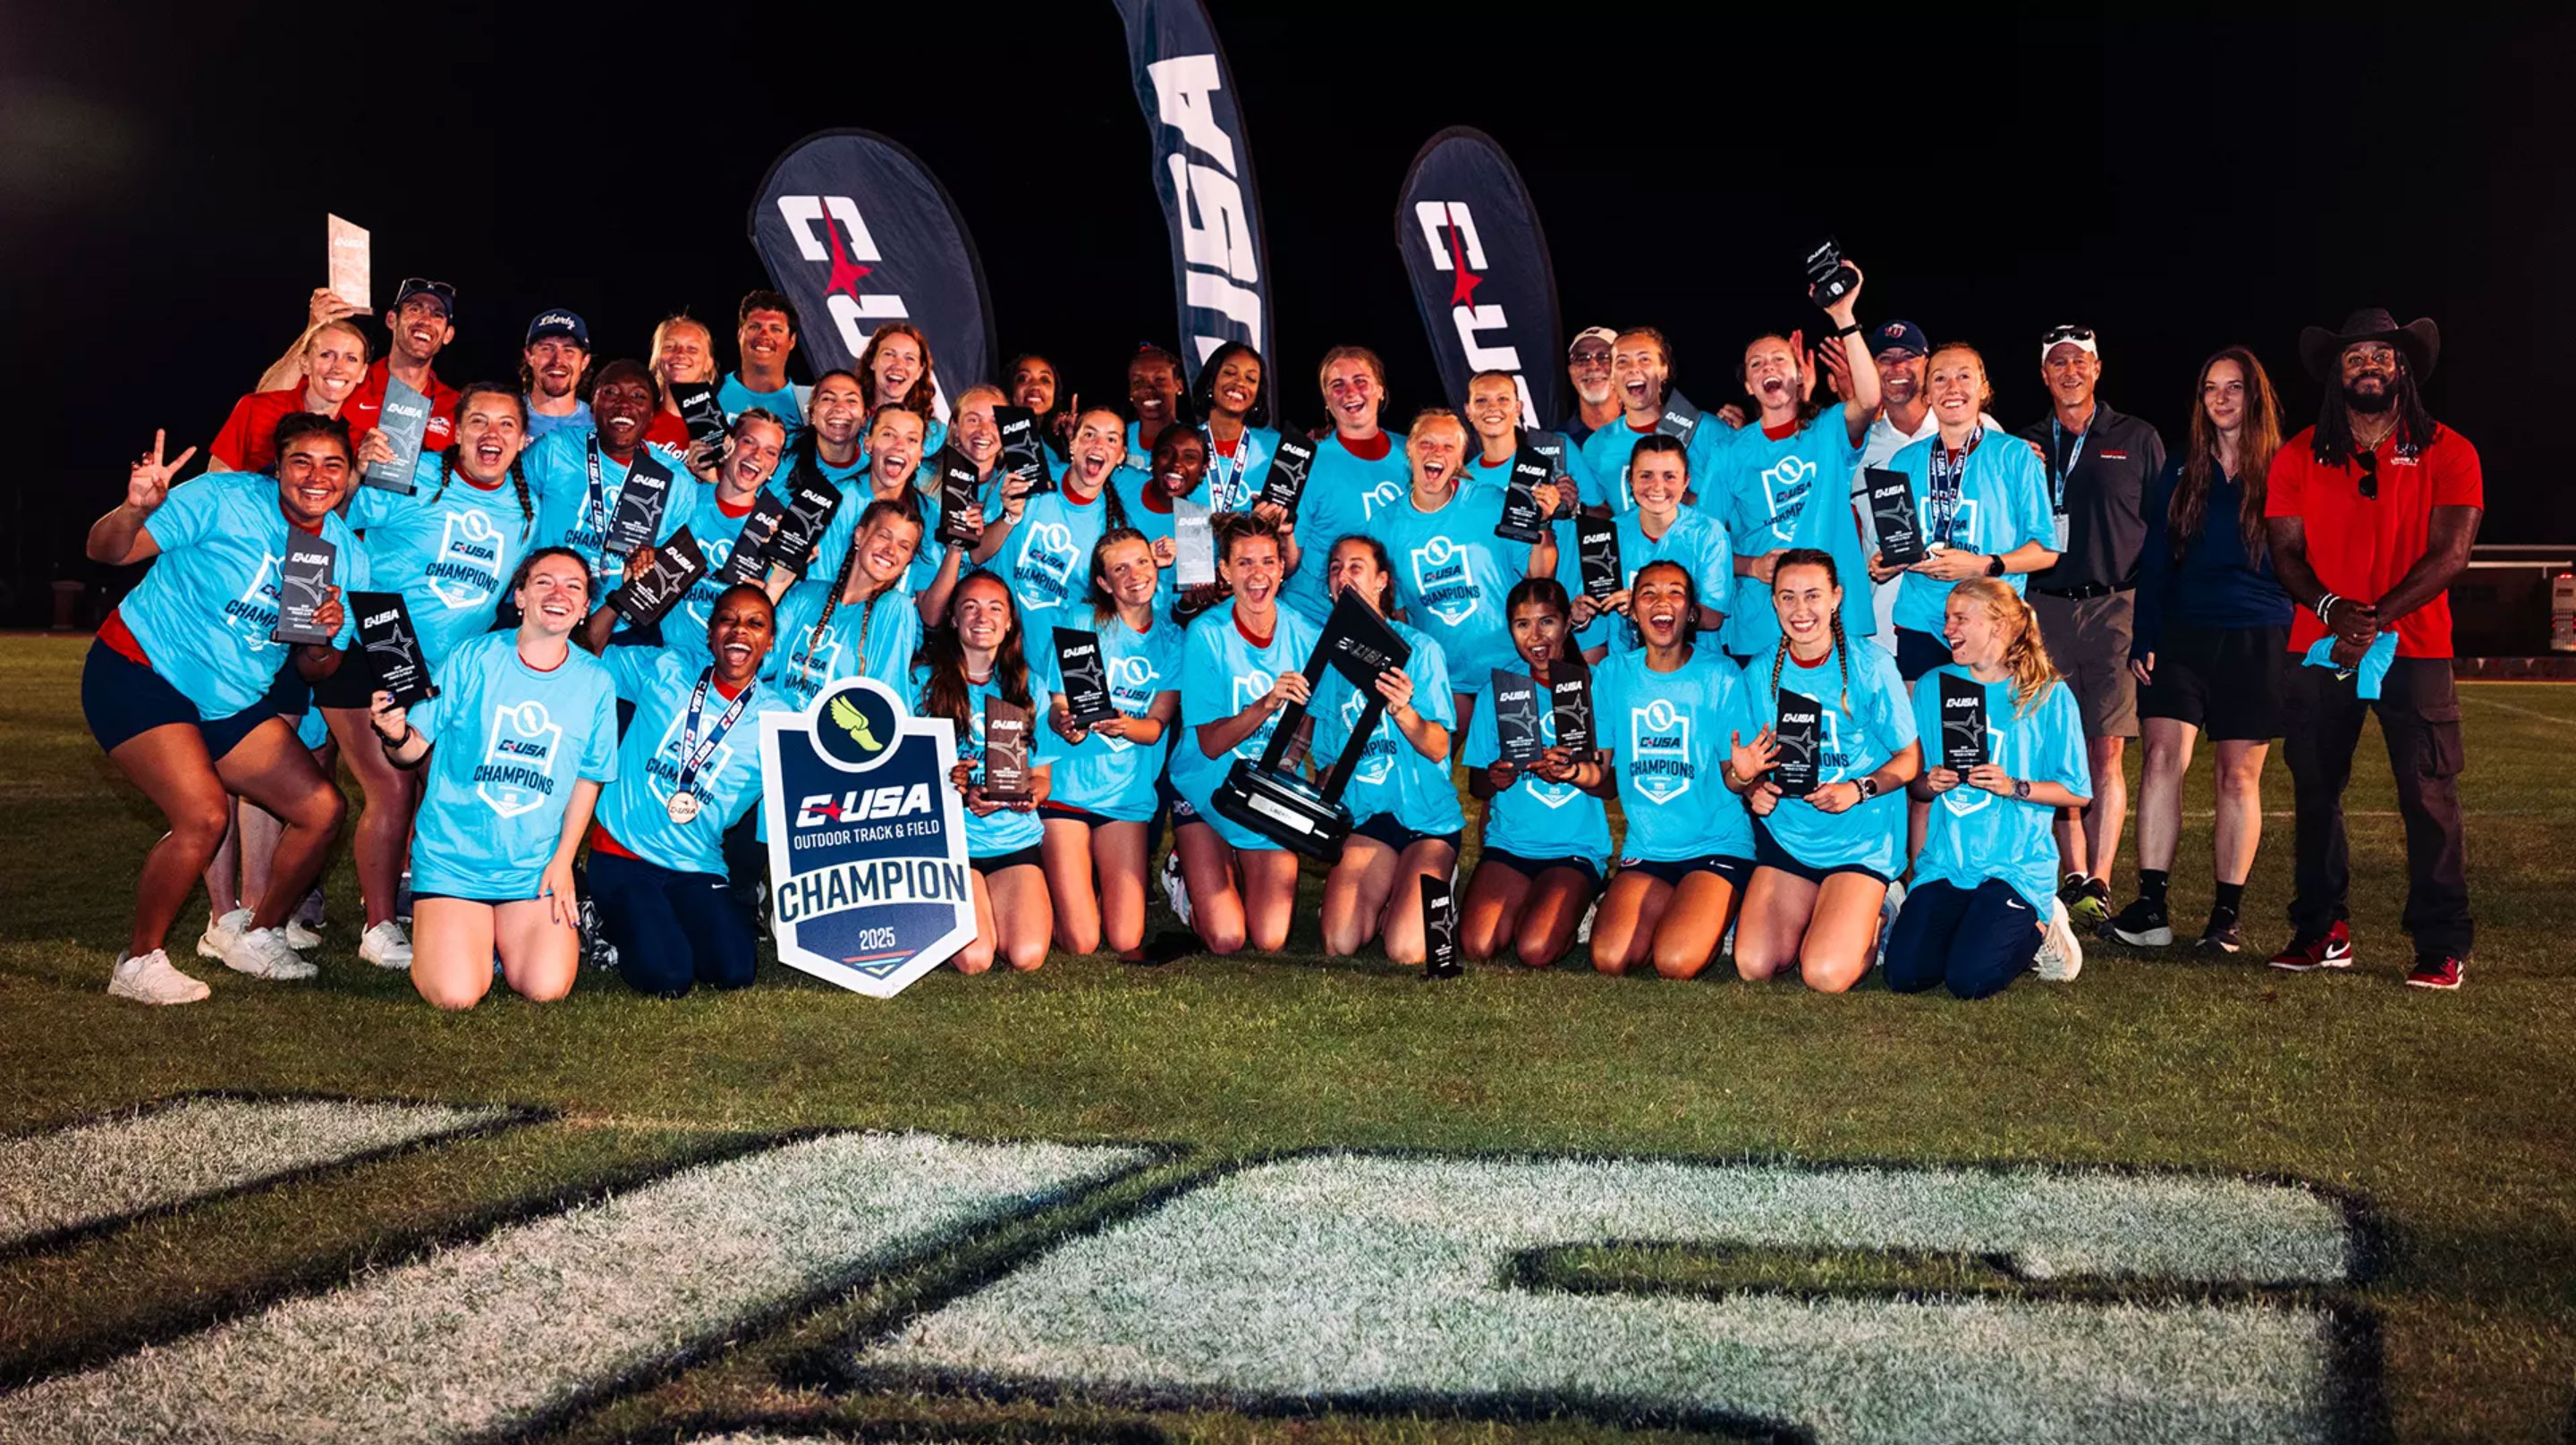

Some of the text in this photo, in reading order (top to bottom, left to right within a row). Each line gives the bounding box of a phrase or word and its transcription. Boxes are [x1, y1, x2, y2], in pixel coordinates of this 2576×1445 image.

[1147, 54, 1261, 367] USA
[425, 562, 499, 595] CHAMPIONS
[1419, 586, 1480, 607] CHAMPIONS
[225, 599, 278, 629] CHAMP
[473, 765, 554, 796] CHAMPIONS
[1630, 759, 1695, 780] CHAMPIONS
[794, 819, 940, 850] OUTDOOR TRACK & FIELD
[777, 860, 967, 923] CHAMPION
[859, 926, 895, 951] 2025
